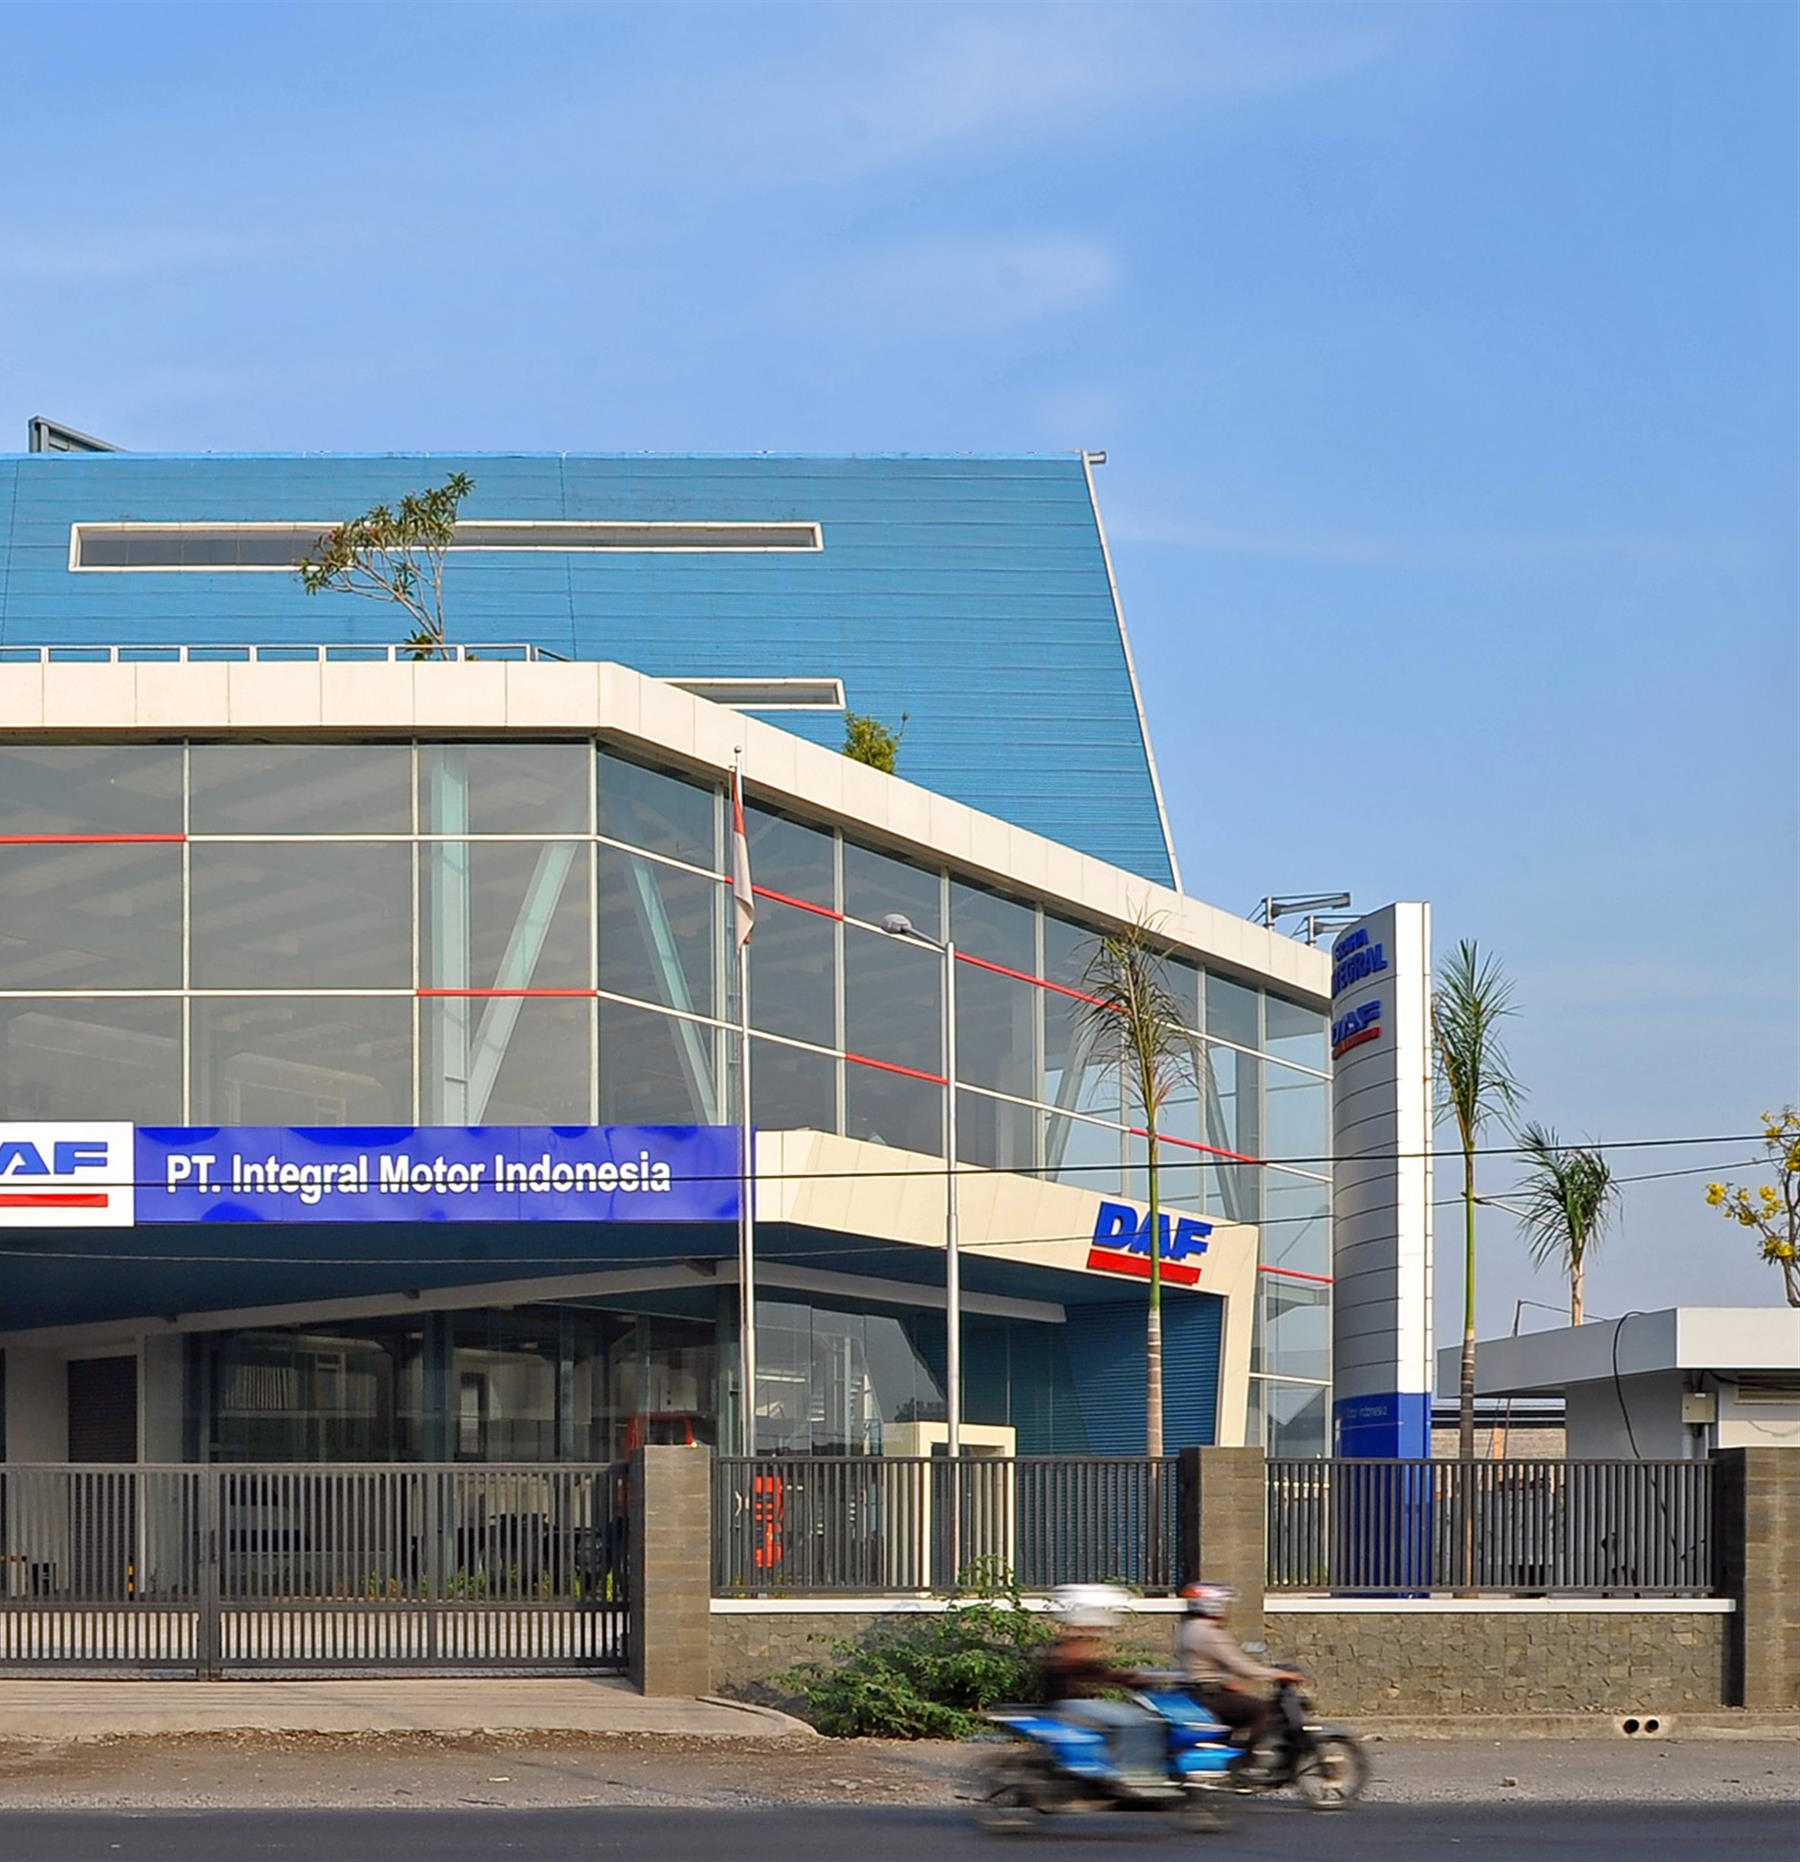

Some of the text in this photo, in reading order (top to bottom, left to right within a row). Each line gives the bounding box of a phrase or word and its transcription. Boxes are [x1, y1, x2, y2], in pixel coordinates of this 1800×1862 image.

[166, 1150, 672, 1205] PT. Integral Motor Indonesia
[1092, 1200, 1213, 1261] DAF
